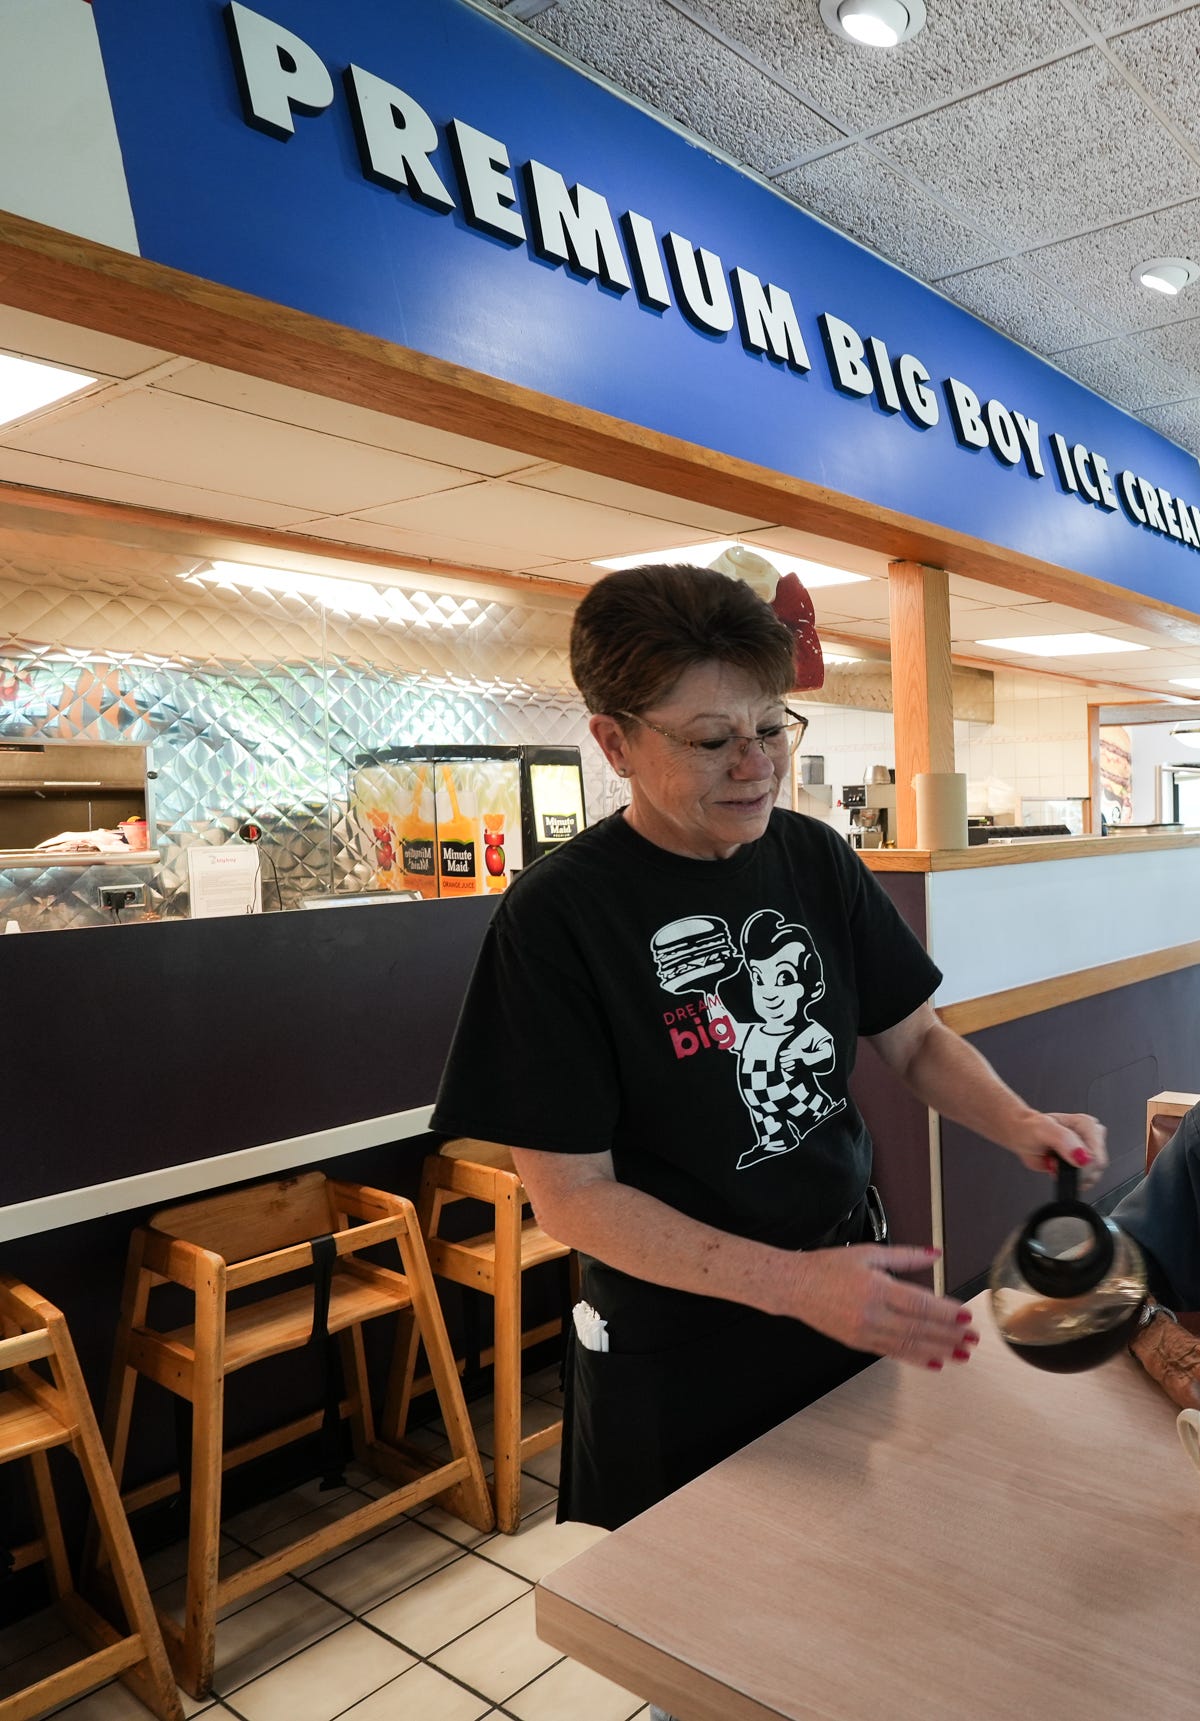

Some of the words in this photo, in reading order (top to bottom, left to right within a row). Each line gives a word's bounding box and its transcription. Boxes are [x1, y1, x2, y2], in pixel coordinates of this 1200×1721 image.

[225, 1, 811, 374] PREMIUM
[818, 311, 940, 427] BIG
[944, 376, 1045, 478] BOY
[1049, 432, 1118, 511] ICE
[443, 847, 472, 861] Minute
[447, 859, 469, 873] Maid
[443, 880, 460, 889] ORANGE
[461, 880, 475, 889] JUICE
[663, 995, 721, 1026] DREAM
[669, 1014, 735, 1059] big
